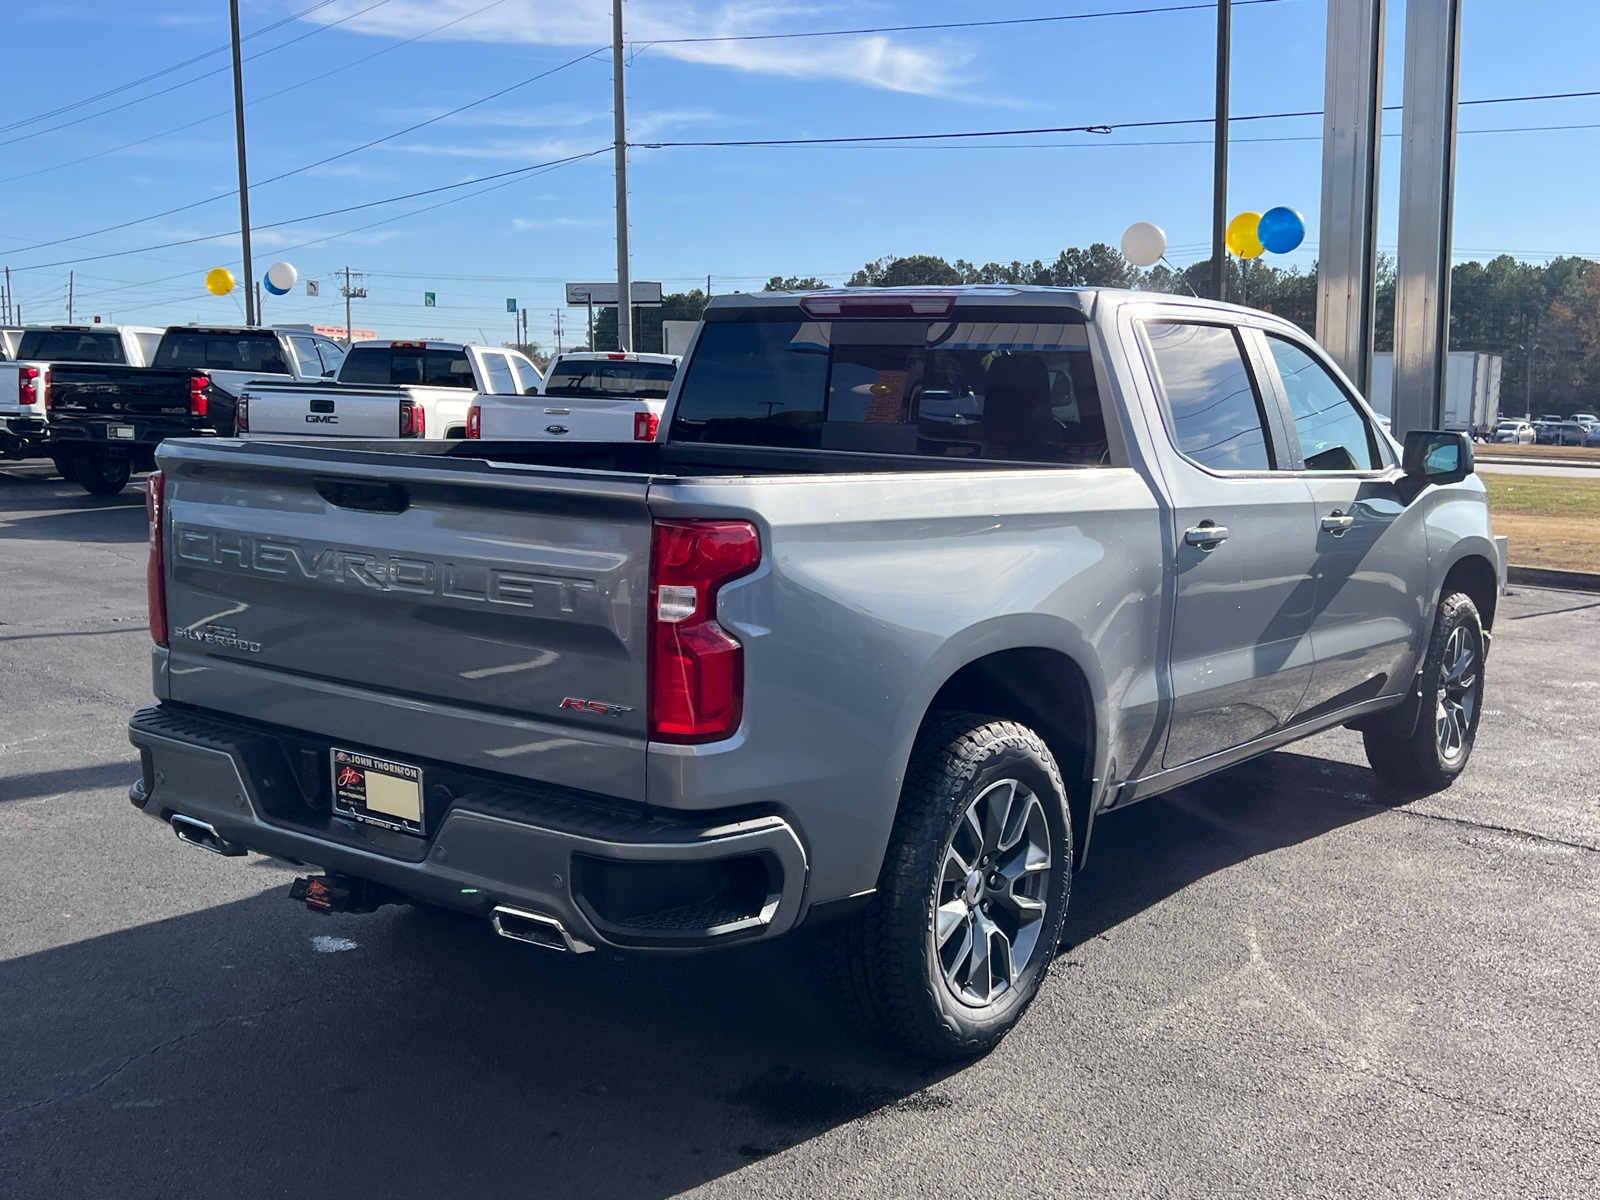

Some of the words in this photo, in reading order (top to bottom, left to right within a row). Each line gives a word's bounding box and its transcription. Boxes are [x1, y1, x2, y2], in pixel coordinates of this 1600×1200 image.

[305, 415, 339, 424] GMC
[177, 528, 600, 613] CHEVROLET
[174, 626, 261, 653] SILVERADO
[559, 697, 635, 718] RST
[351, 755, 372, 767] JOHN
[373, 761, 417, 778] THORNTON
